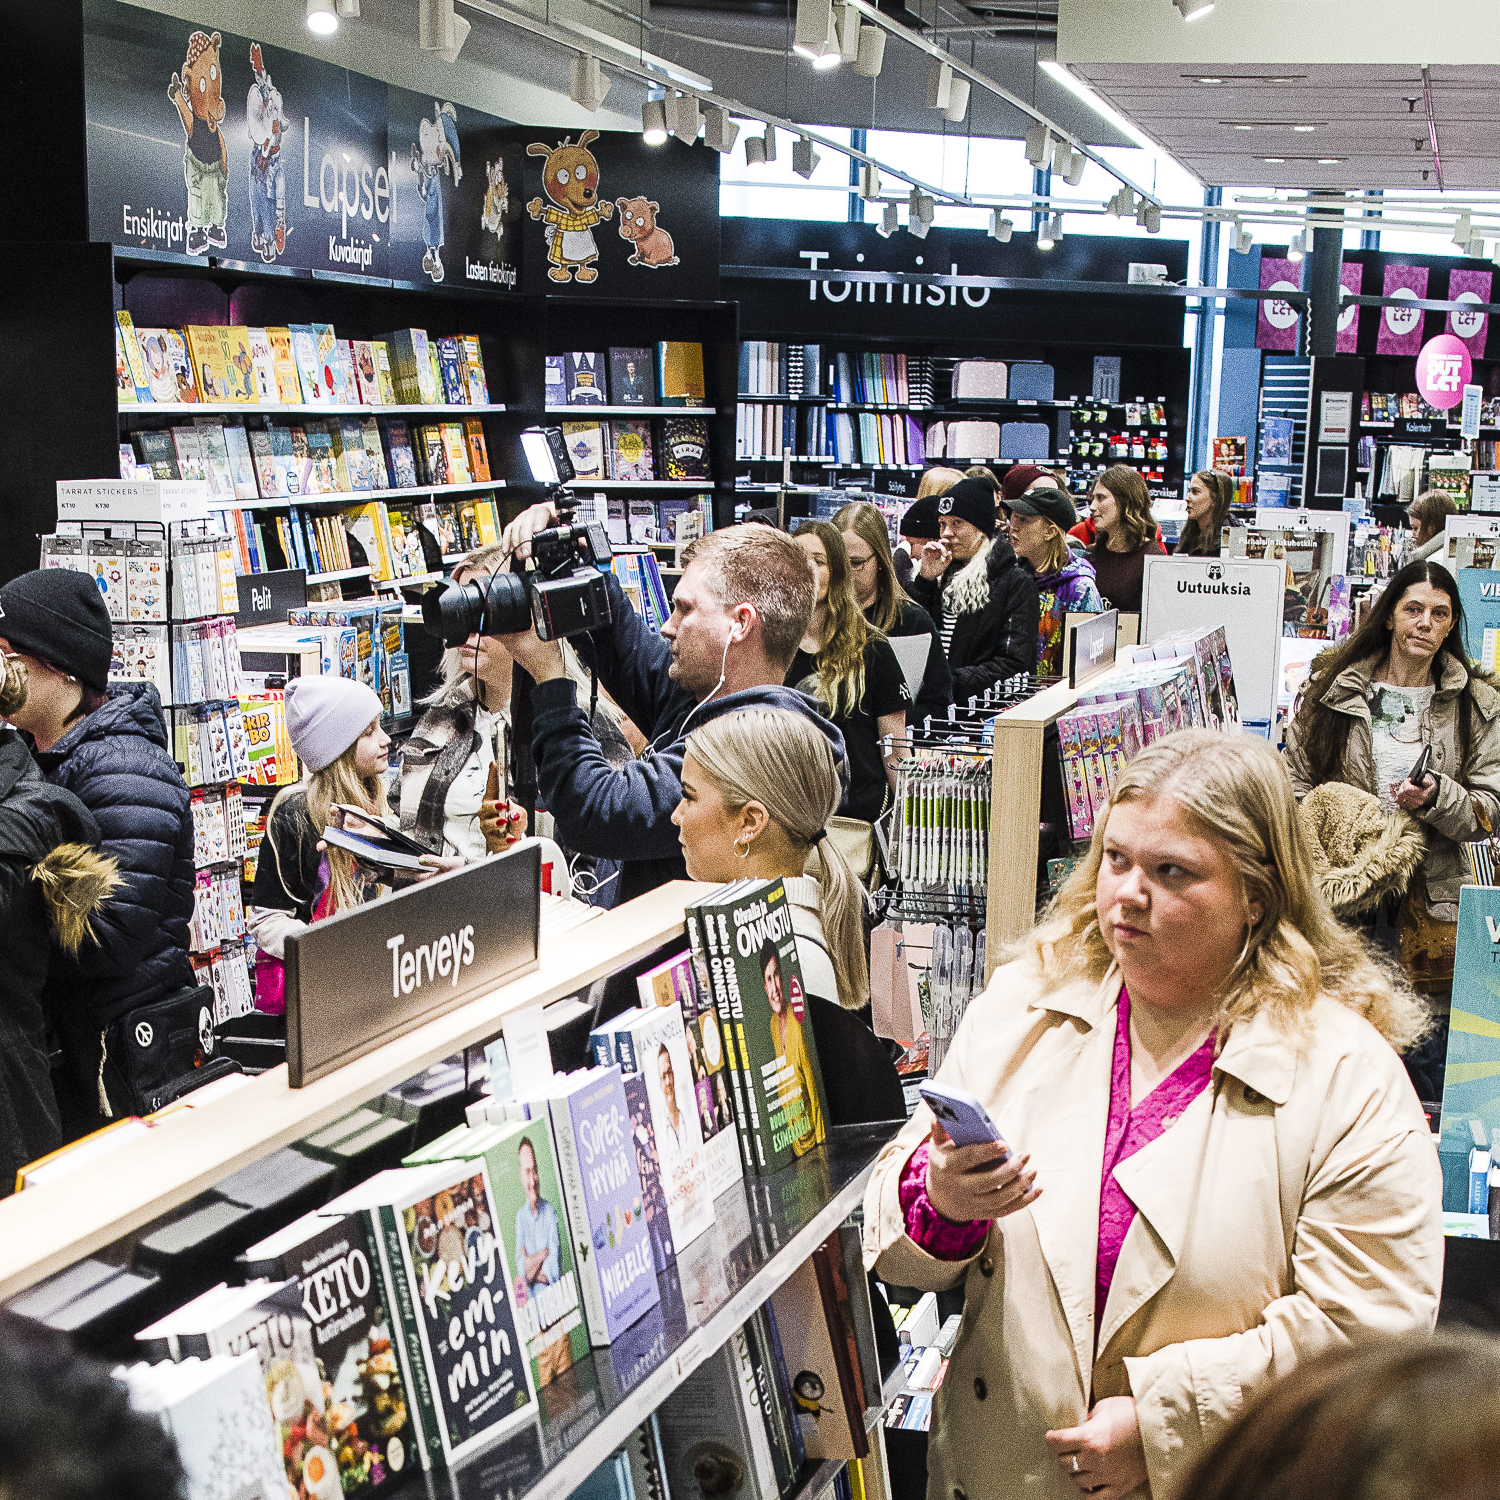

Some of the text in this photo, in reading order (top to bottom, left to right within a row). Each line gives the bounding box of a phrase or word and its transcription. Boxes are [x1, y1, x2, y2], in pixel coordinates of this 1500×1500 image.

[122, 204, 184, 243] Ensikirjat
[329, 234, 373, 271] Kuvakirjat
[465, 256, 488, 281] Lasten
[800, 250, 991, 308] Toimisto
[1427, 360, 1462, 377] OUT
[675, 446, 701, 456] KIRJA
[61, 487, 139, 496] TARRAT STICKERS
[252, 587, 272, 612] Pelit
[1177, 580, 1251, 596] Uutuuksia
[248, 727, 271, 746] BO
[266, 762, 278, 777] 12
[736, 904, 792, 958] ONNISTU
[386, 922, 476, 999] Terveys
[711, 957, 731, 1020] ONNISTU
[723, 957, 744, 1019] ONNISTU
[588, 1146, 632, 1201] HYVÄÄ
[301, 1247, 373, 1322] KETO
[600, 1237, 652, 1306] MIELELLE
[448, 1328, 512, 1402] min
[756, 1364, 773, 1416] KETO
